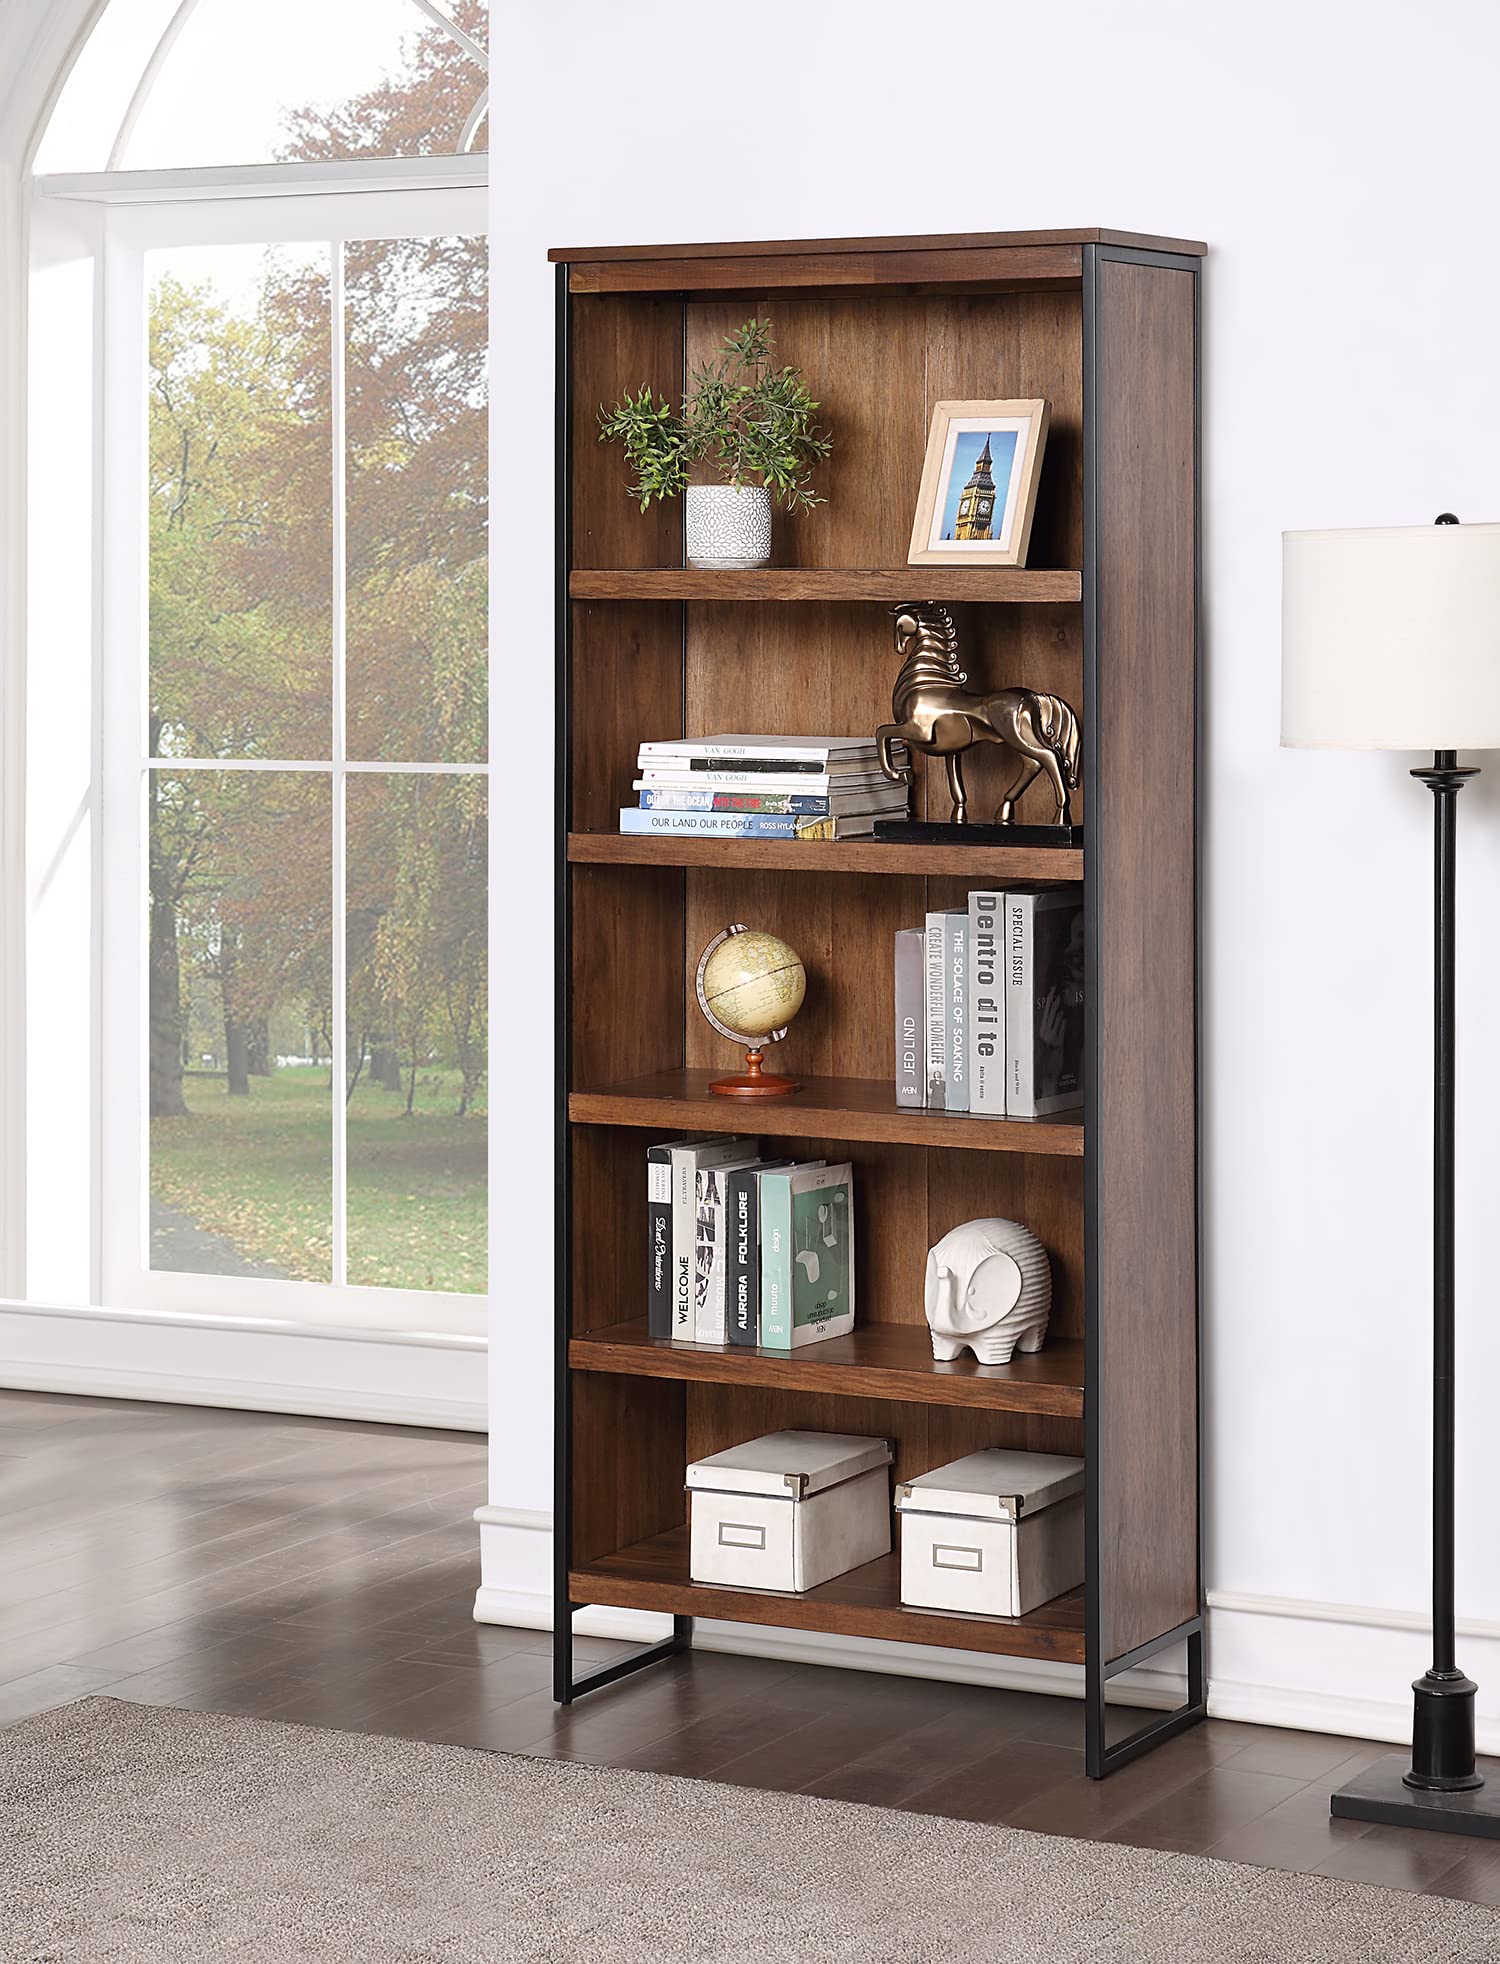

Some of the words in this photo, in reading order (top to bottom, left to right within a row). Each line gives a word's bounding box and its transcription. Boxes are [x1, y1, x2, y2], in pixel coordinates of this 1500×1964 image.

[704, 746, 721, 754] VAN
[723, 747, 746, 755] GOGH
[706, 773, 723, 781] VAN
[725, 774, 747, 782] GOGH
[687, 796, 710, 807] OCEAN
[651, 817, 670, 827] OUR
[672, 818, 697, 828] LAND
[699, 819, 718, 829] OUR
[720, 820, 753, 830] PEOPLE
[760, 822, 777, 830] ROSS
[778, 823, 802, 831] HYLAND
[929, 927, 942, 959] CREATE
[953, 930, 964, 953] THE
[976, 896, 997, 985] Dentro
[1012, 907, 1023, 951] SPECIAL
[953, 957, 964, 1003] SOLACE
[1012, 955, 1023, 986] ISSUE
[930, 962, 944, 1017] WONDERFUL
[953, 1007, 963, 1024] OF
[977, 998, 998, 1023] di
[903, 1016, 916, 1048] LIND
[931, 1020, 944, 1065] HOMELIFE
[977, 1032, 998, 1057] te
[903, 1051, 916, 1076] JED
[953, 1027, 963, 1082] SOAKING
[738, 1191, 748, 1265] FOLKLORE
[771, 1228, 780, 1253] design
[678, 1256, 689, 1325] WELCOME
[737, 1275, 748, 1330] AURORA
[770, 1283, 778, 1316] muuto
